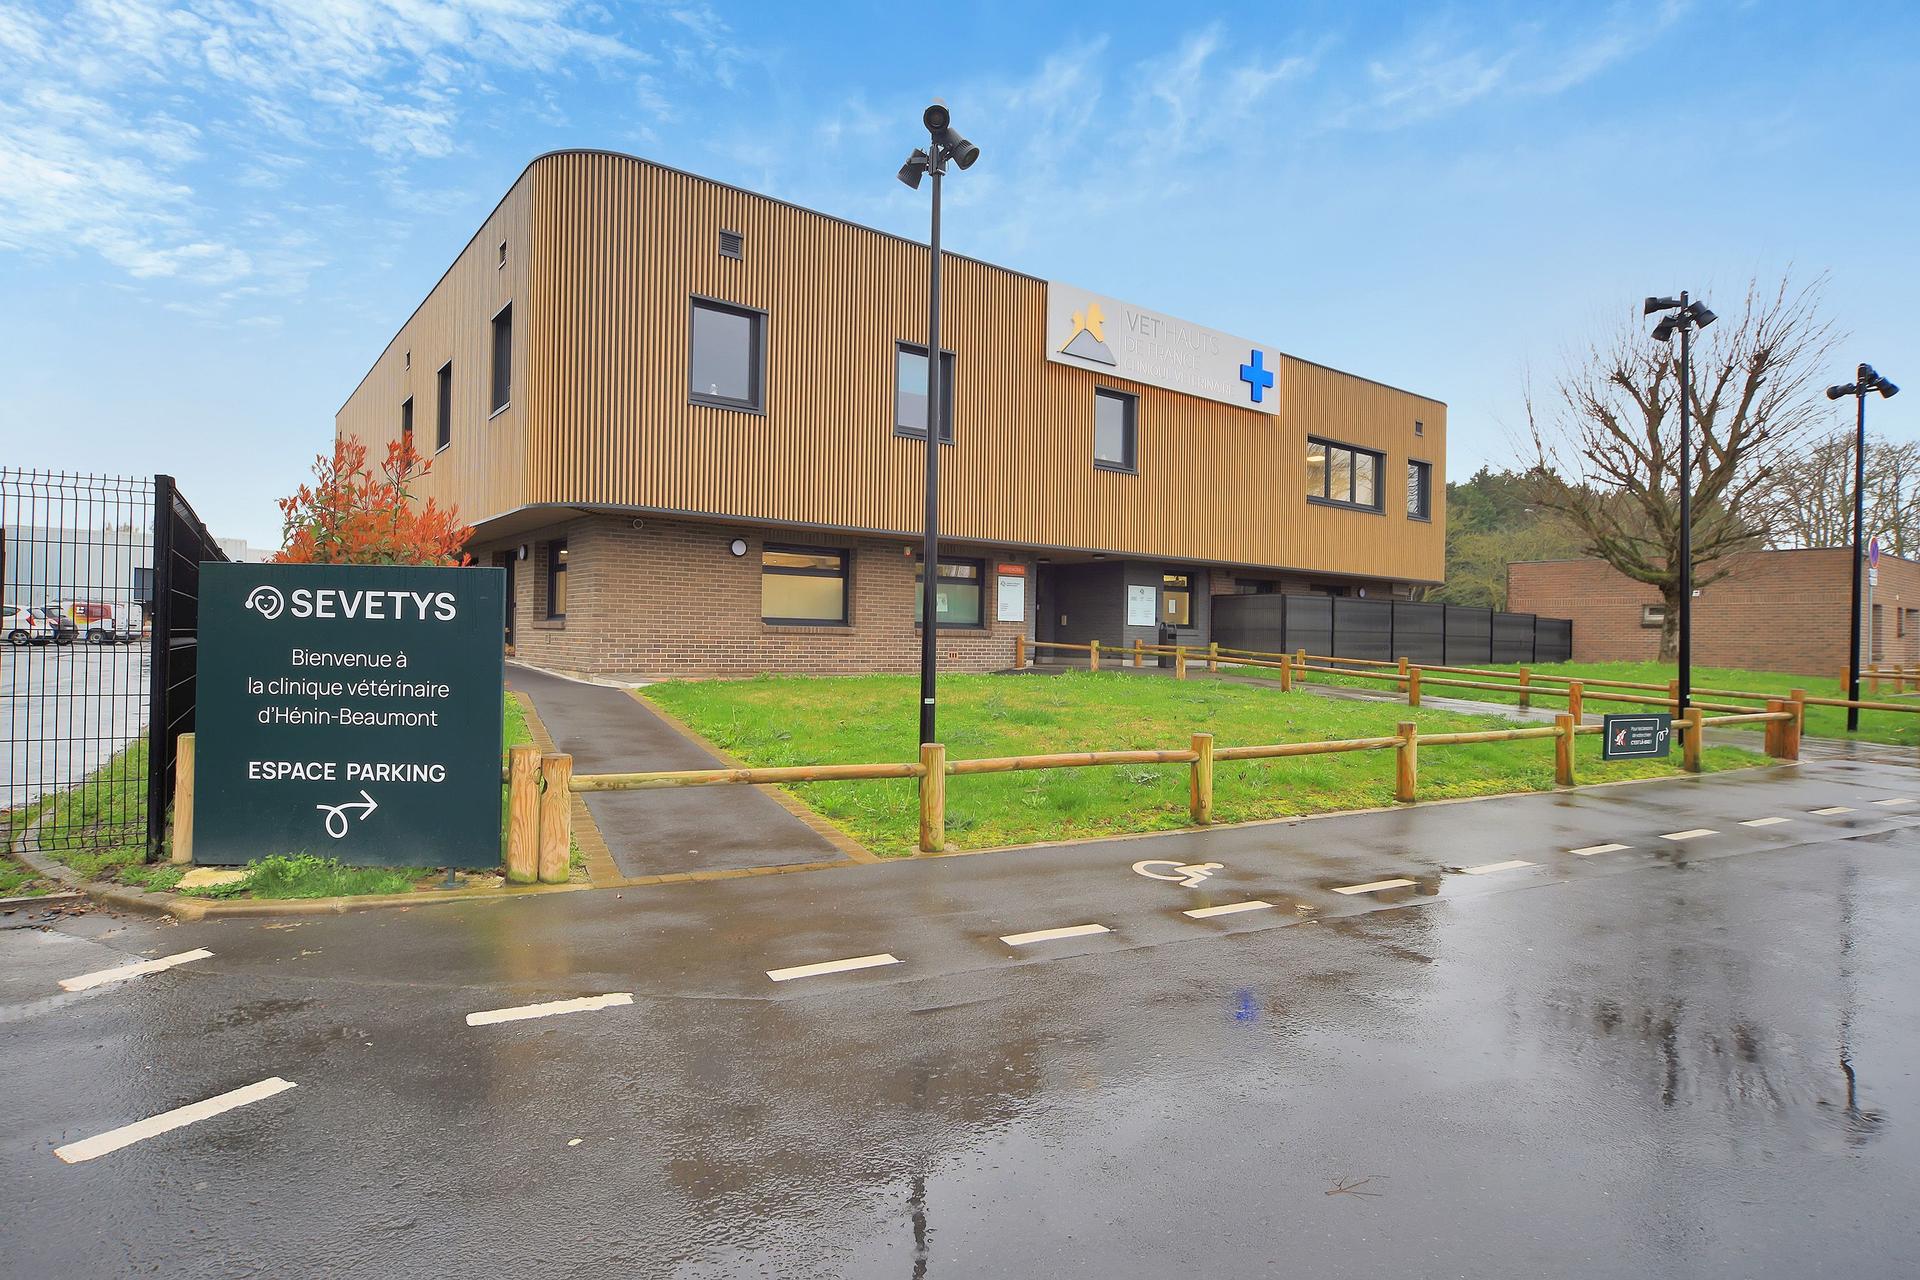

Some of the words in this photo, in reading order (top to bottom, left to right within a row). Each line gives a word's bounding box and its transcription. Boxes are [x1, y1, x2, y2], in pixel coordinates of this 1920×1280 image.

[291, 589, 457, 621] SEVETYS
[292, 649, 392, 667] Bienvenue
[396, 650, 408, 668] à
[248, 677, 264, 694] la
[268, 678, 343, 700] clinique
[347, 680, 450, 698] vétérinaire
[258, 707, 438, 727] d'Hénin-Beaumont
[248, 761, 336, 781] ESPACE
[346, 763, 446, 783] PARKING
